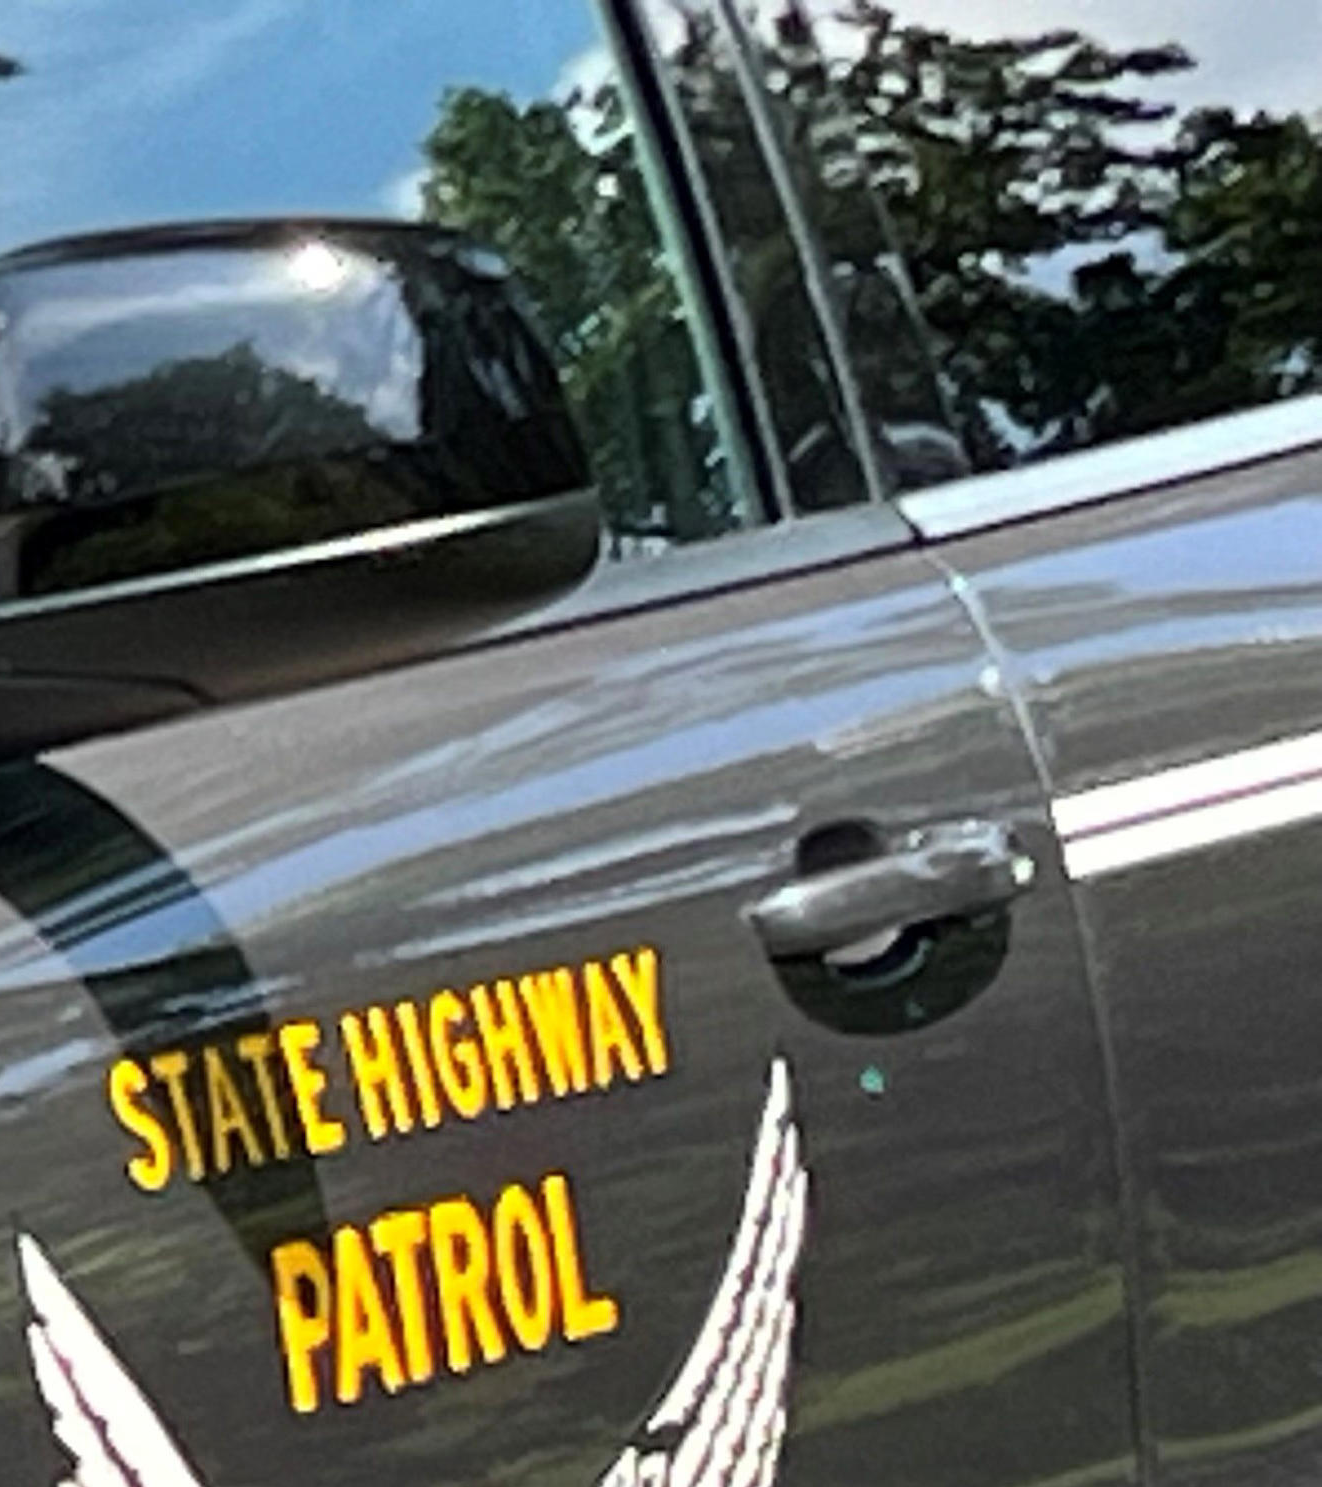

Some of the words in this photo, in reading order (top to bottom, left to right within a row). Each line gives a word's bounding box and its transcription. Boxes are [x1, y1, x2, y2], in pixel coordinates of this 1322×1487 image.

[106, 1018, 348, 1192] STATE
[338, 944, 669, 1140] HIGHWAY
[269, 1173, 621, 1414] PATROL
